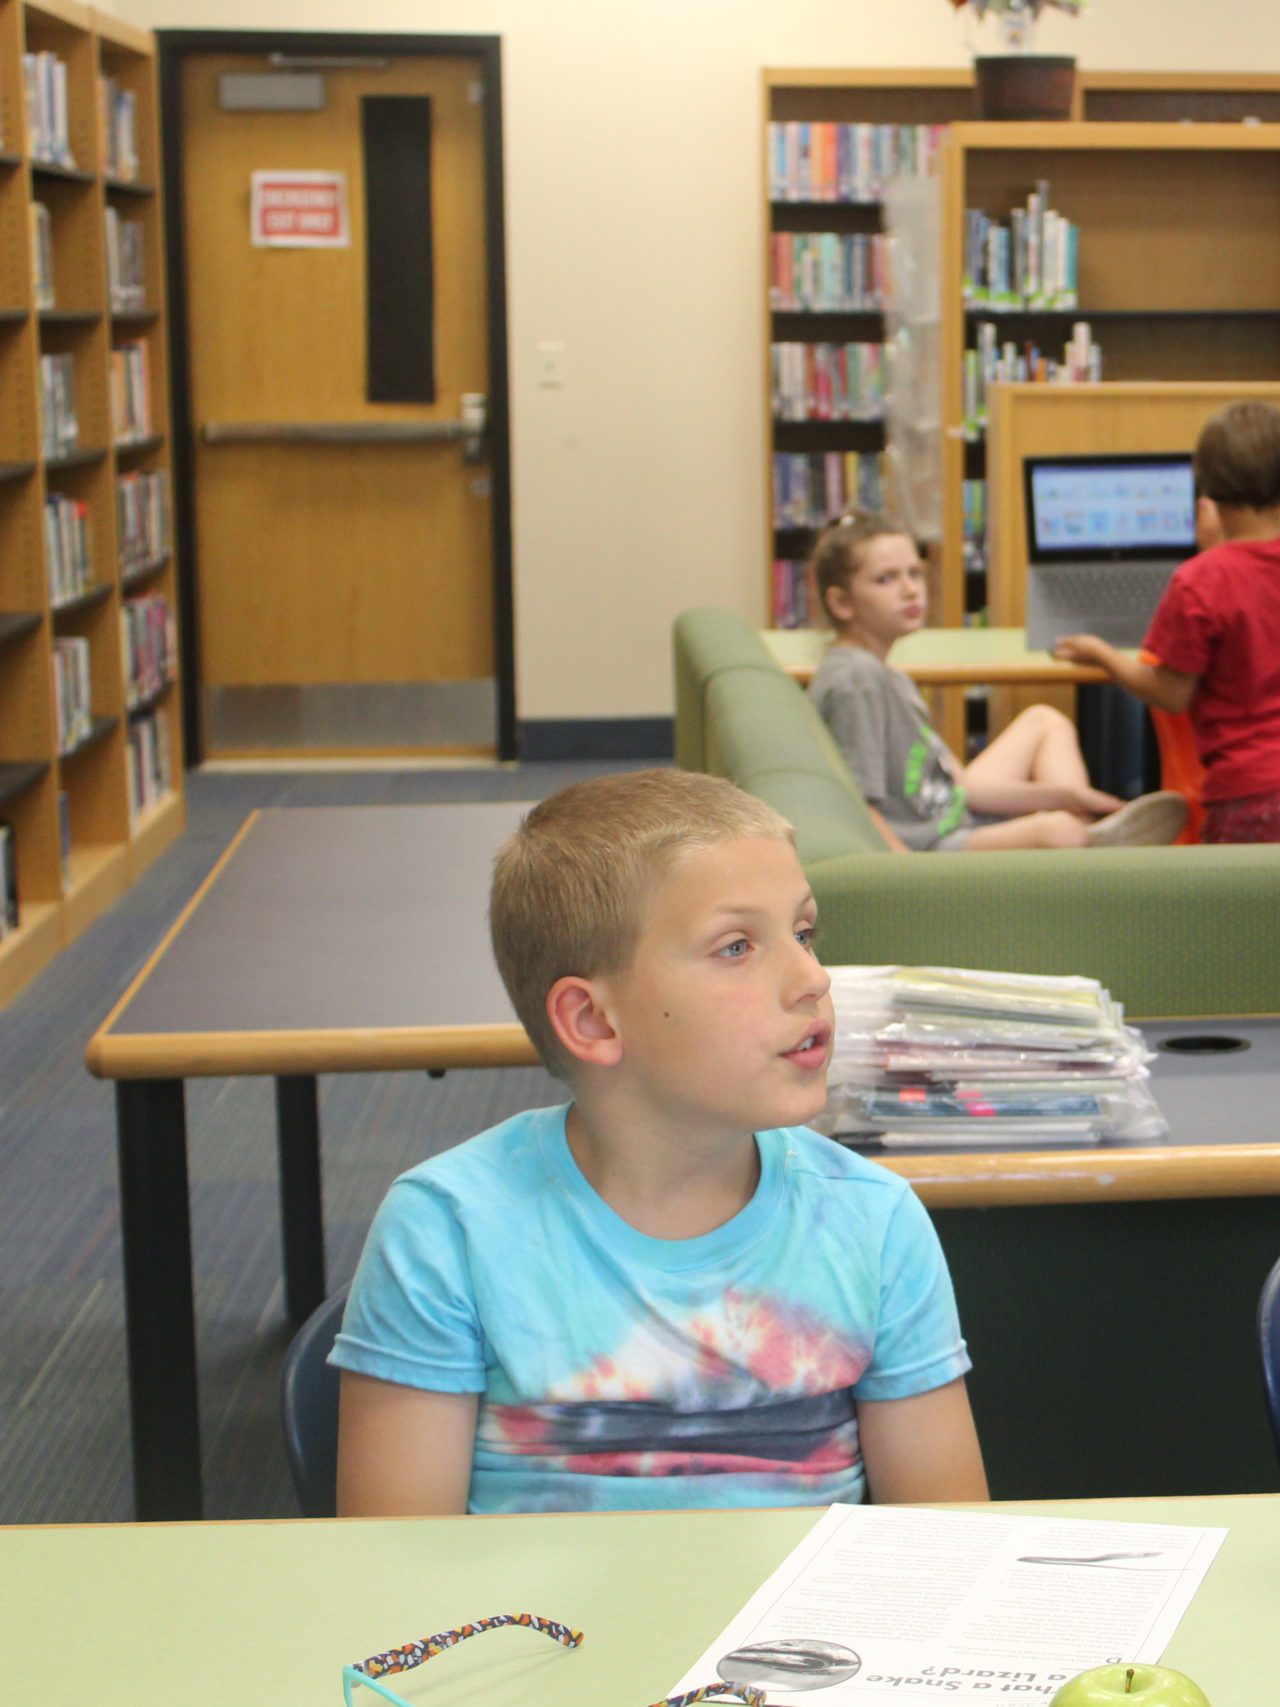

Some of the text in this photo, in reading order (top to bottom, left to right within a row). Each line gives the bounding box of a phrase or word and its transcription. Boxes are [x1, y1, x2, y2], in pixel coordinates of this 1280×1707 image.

[921, 1666, 1067, 1682] a Lizard?
[867, 1673, 1056, 1694] hat a Snake
